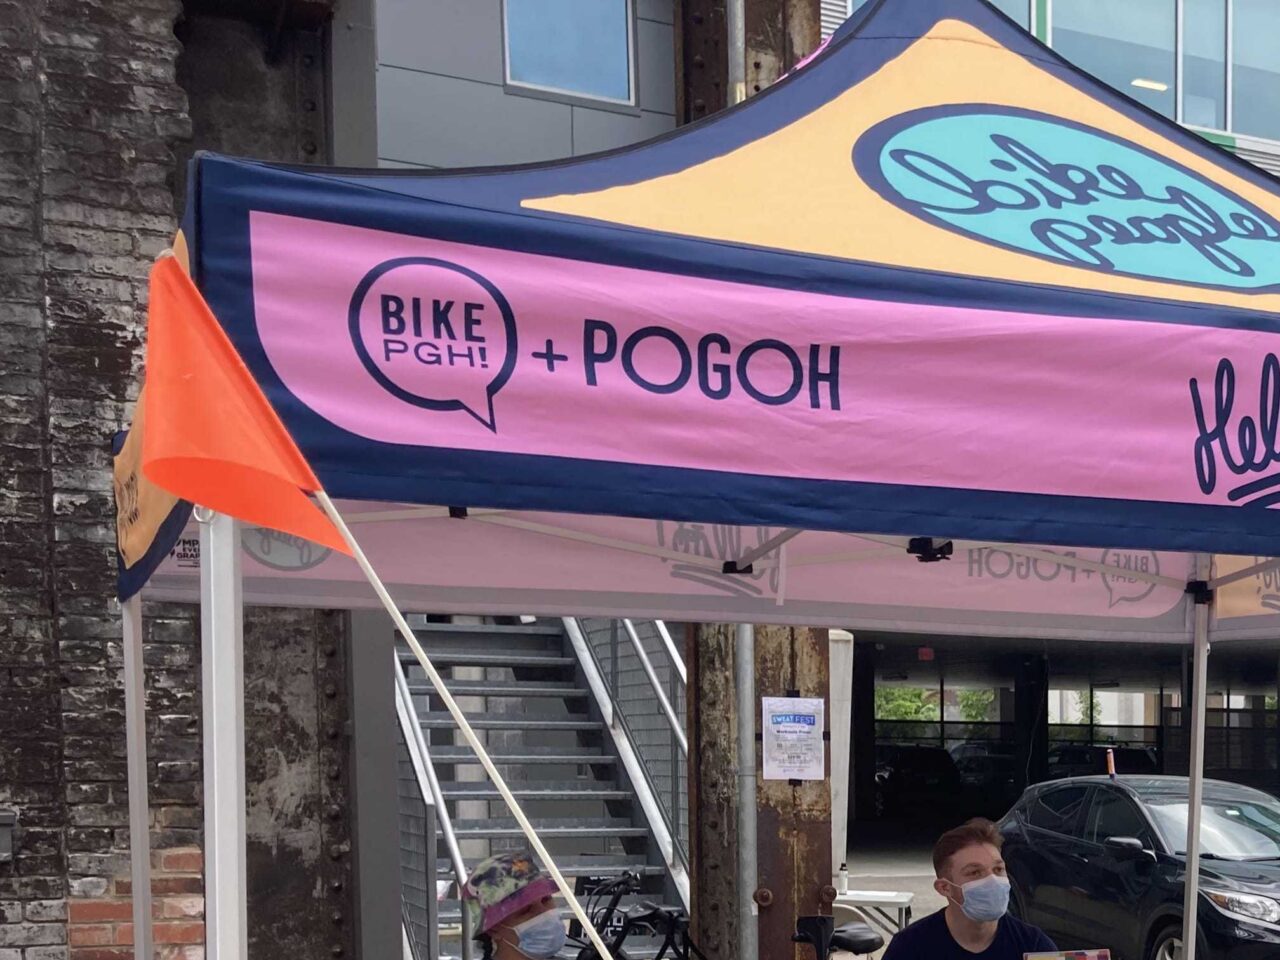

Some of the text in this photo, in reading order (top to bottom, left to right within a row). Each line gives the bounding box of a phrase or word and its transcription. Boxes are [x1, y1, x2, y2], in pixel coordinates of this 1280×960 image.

[889, 134, 1145, 215] bike
[380, 294, 487, 343] BIKE
[383, 339, 489, 369] PGH!
[584, 319, 842, 411] POGOH
